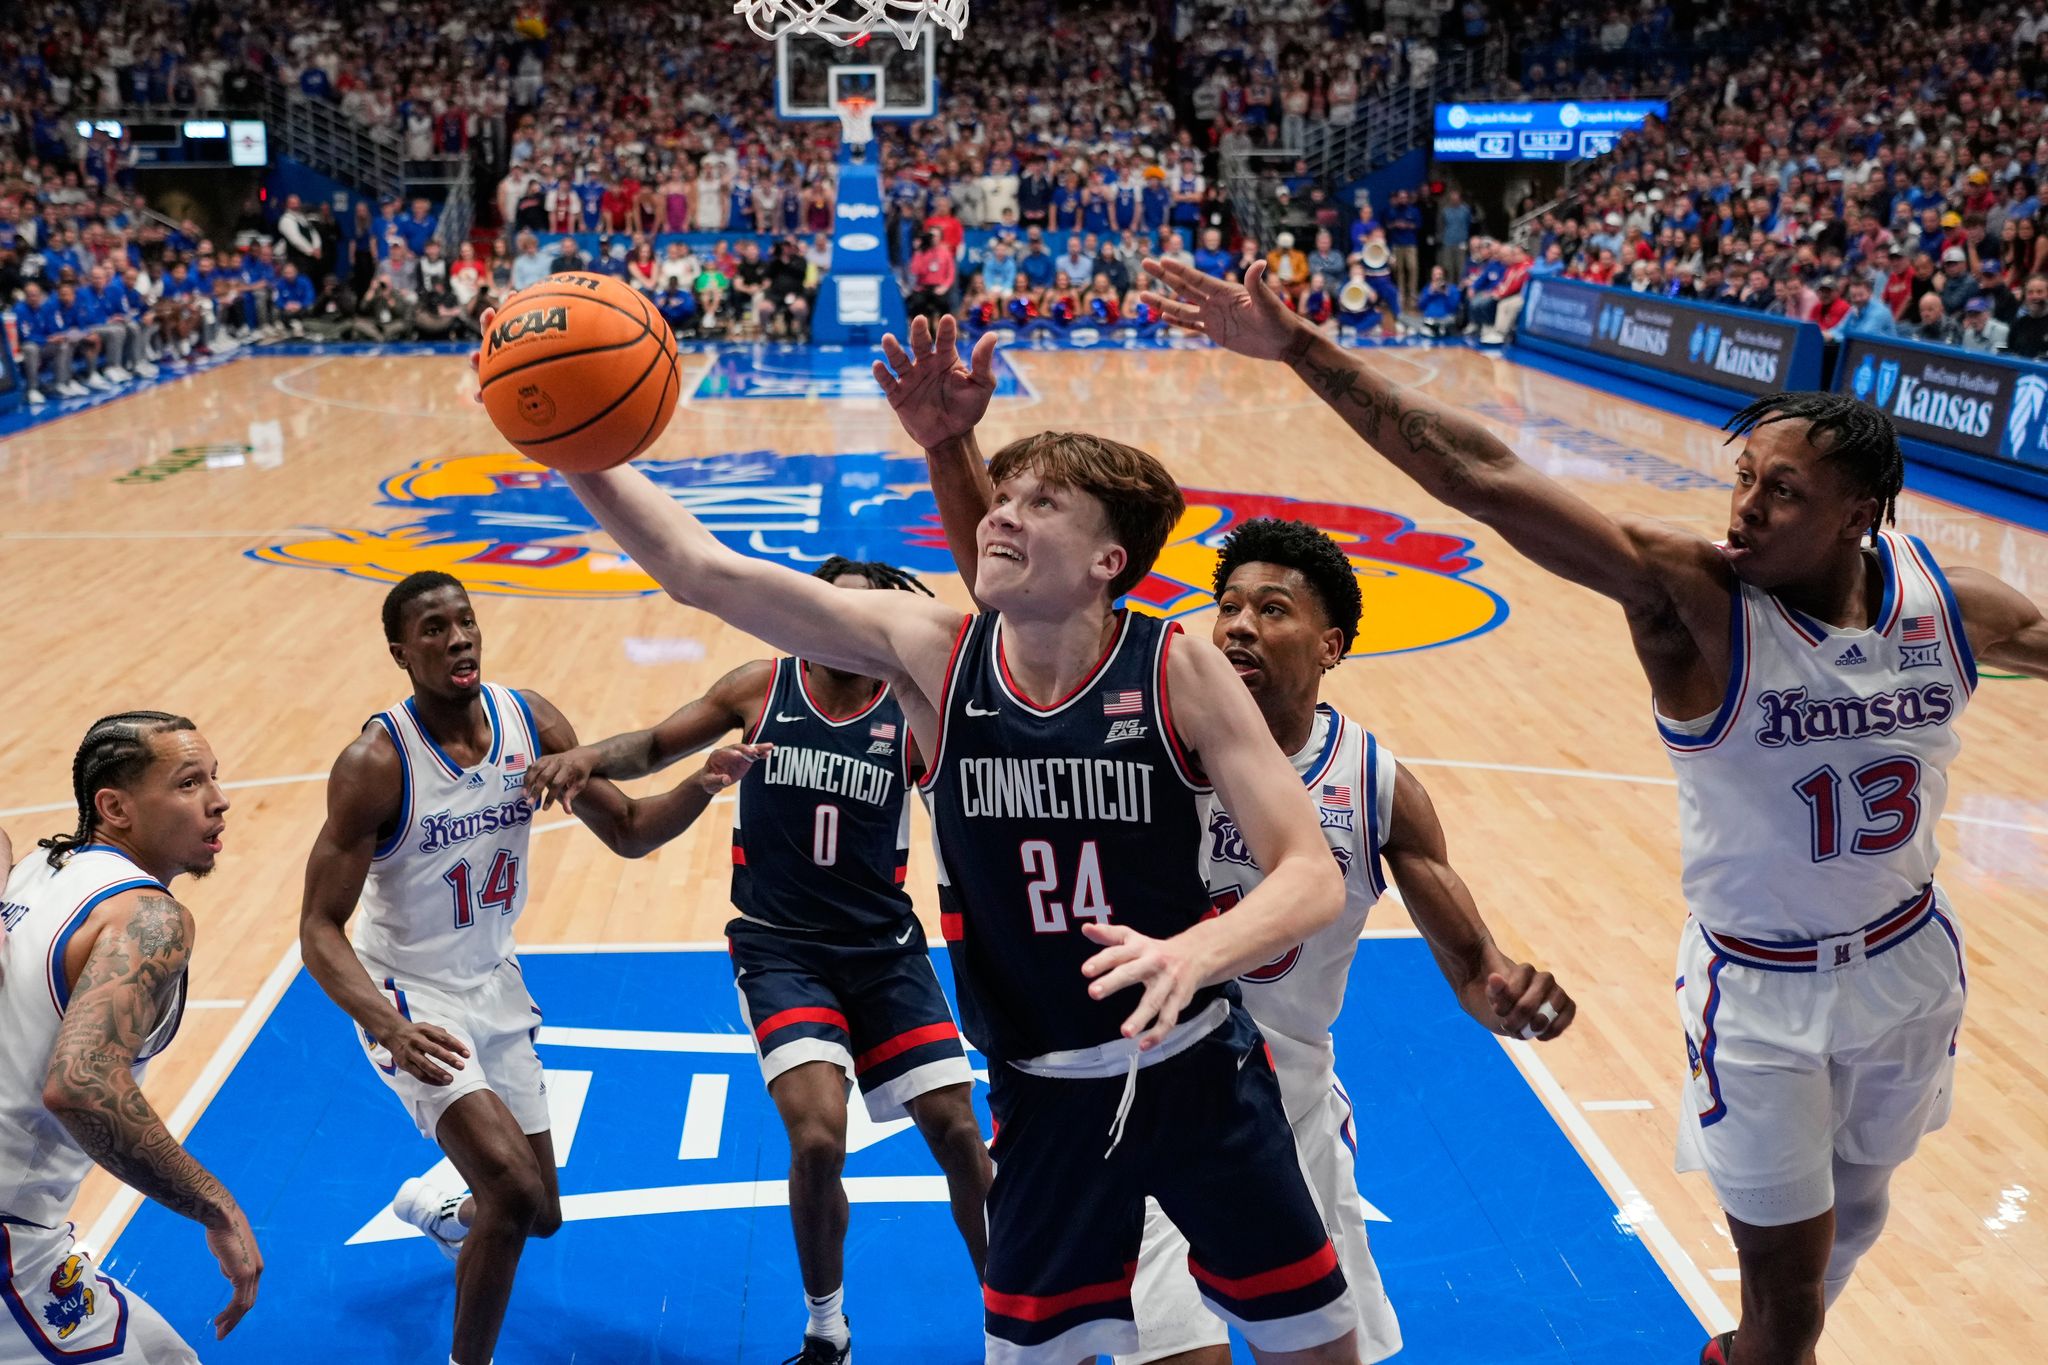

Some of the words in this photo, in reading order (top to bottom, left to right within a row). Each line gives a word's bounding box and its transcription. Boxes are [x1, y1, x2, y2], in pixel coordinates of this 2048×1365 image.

[488, 307, 568, 358] NCAA
[1714, 336, 1778, 383] Kansas
[1893, 375, 1993, 438] Kansas
[1107, 727, 1148, 739] EAST
[1111, 719, 1140, 730] BIG
[1756, 682, 1953, 748] Kansas
[765, 746, 895, 807] CONNECTICUT
[960, 758, 1154, 823] CONNECTICUT
[420, 798, 533, 853] Kansas
[814, 804, 838, 867] 0
[1793, 755, 1921, 863] 13
[443, 848, 519, 929] 14
[1020, 840, 1112, 933] 24
[61, 1297, 78, 1315] KU
